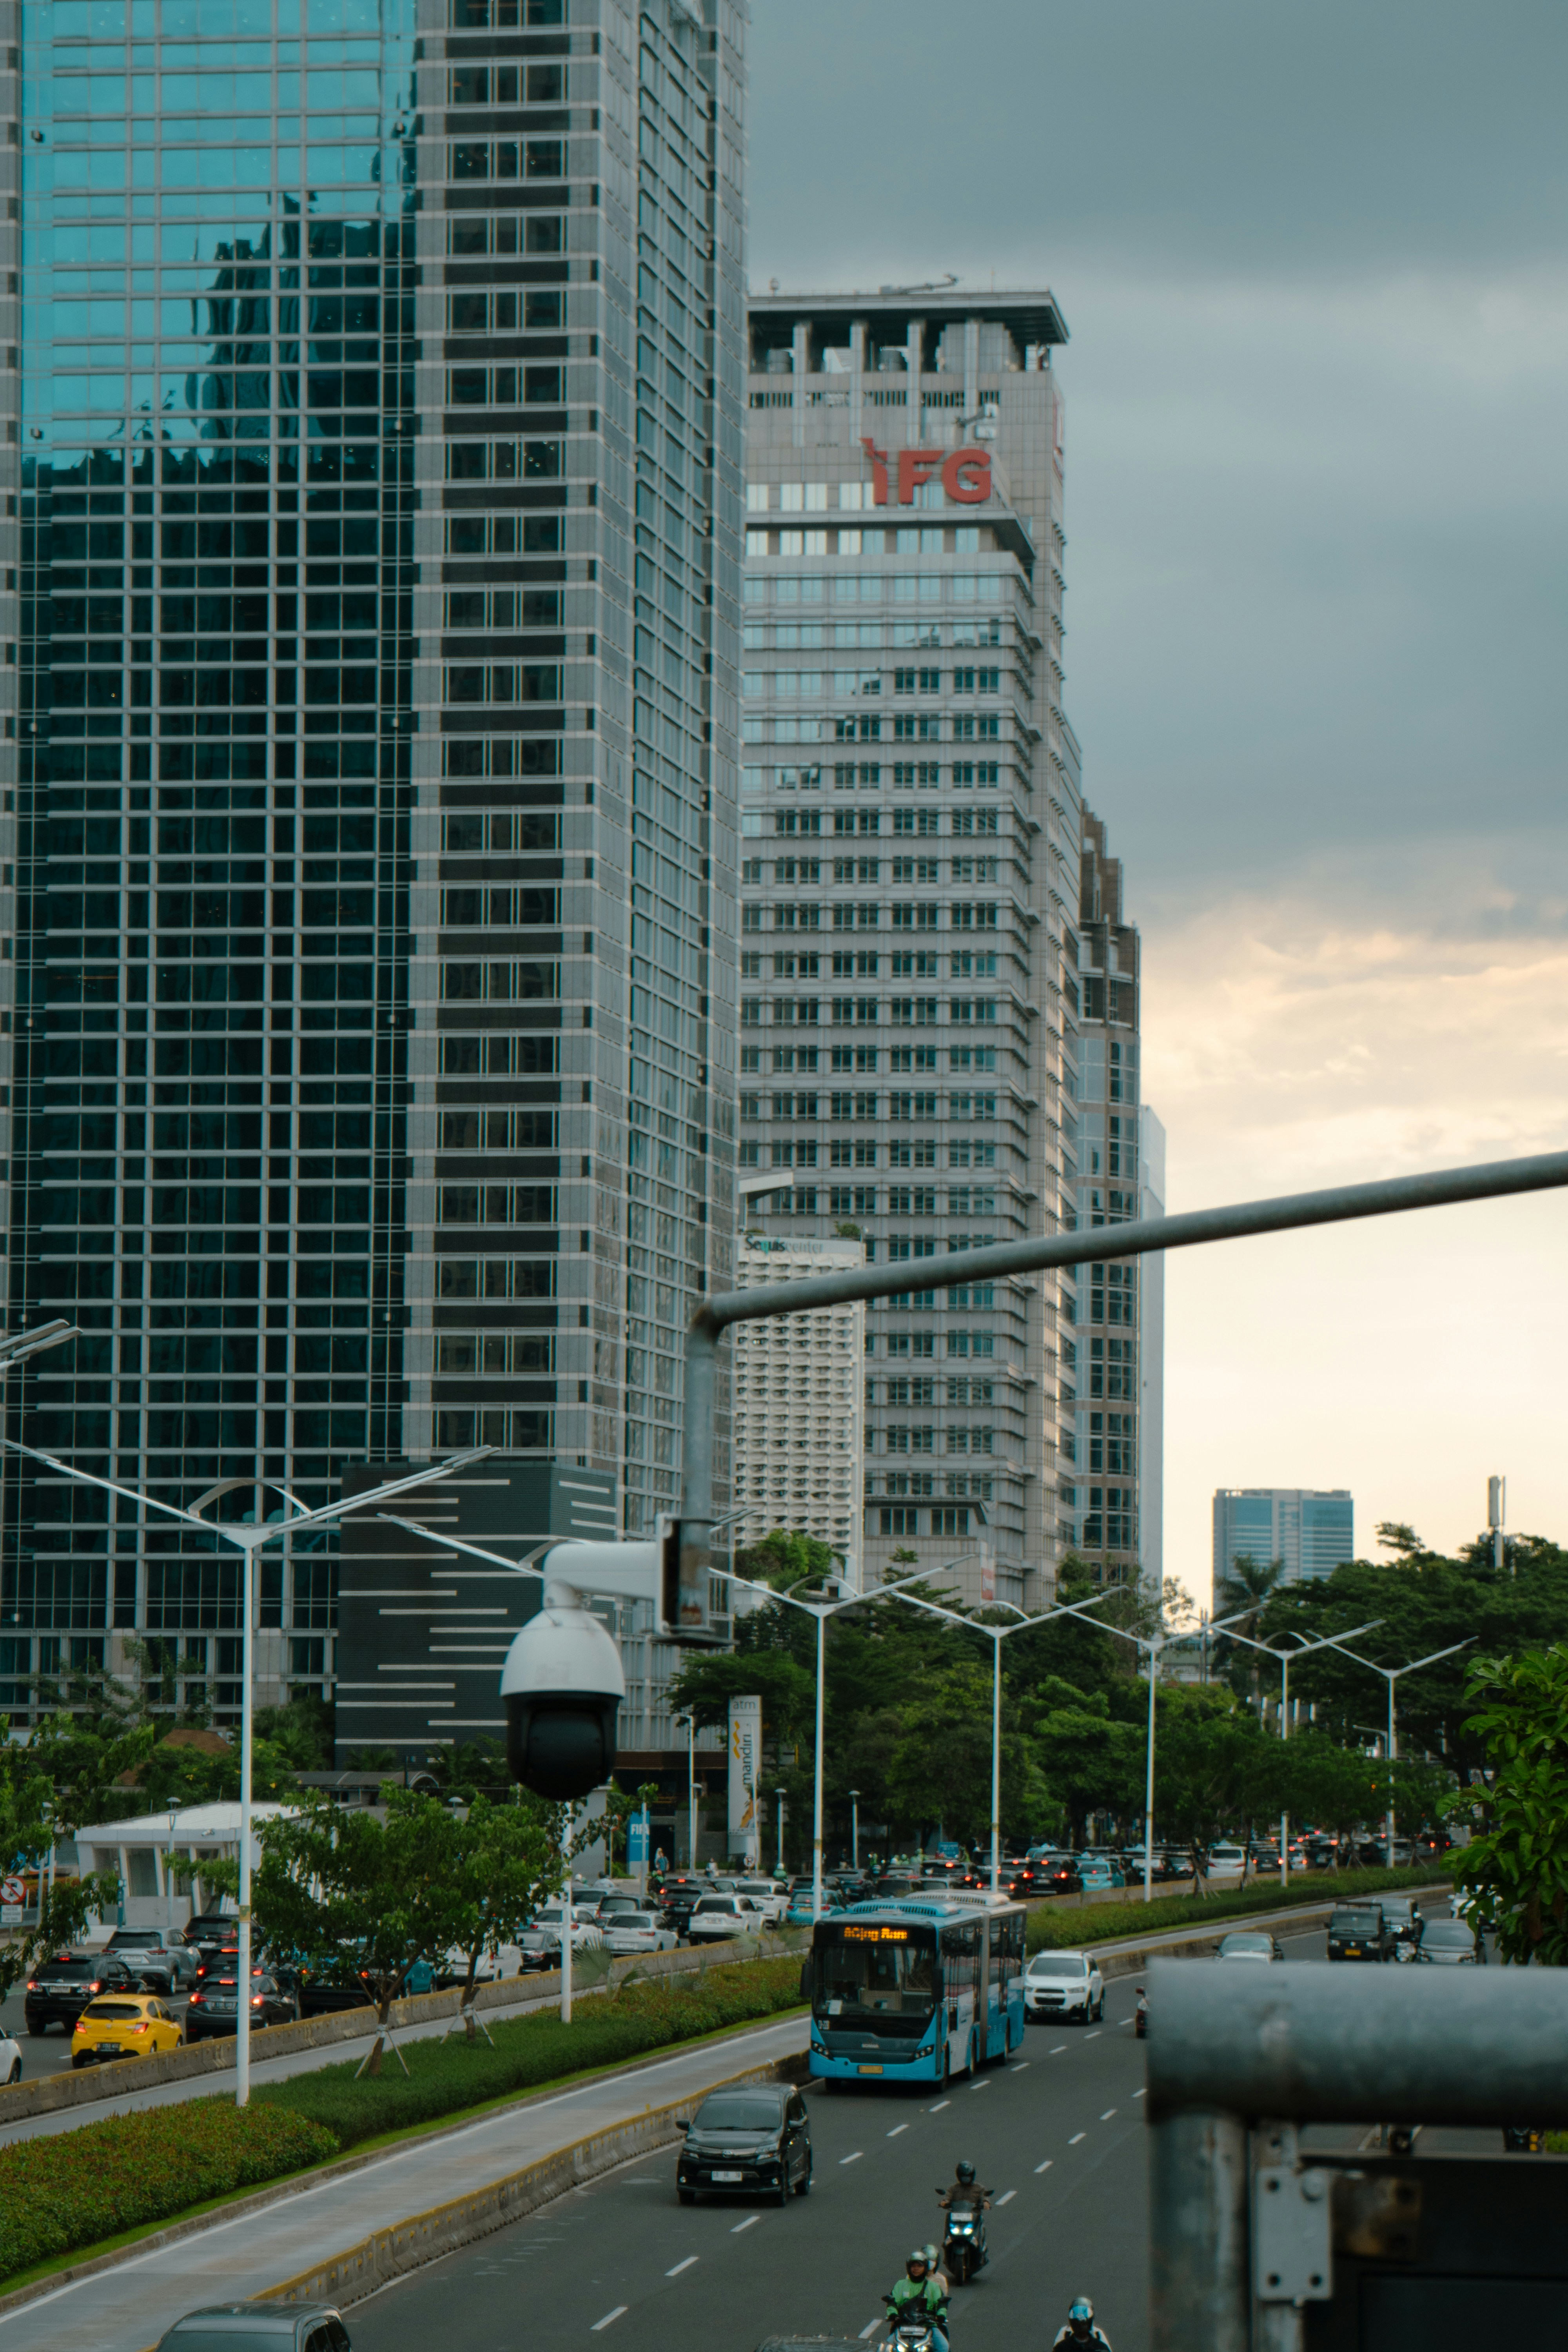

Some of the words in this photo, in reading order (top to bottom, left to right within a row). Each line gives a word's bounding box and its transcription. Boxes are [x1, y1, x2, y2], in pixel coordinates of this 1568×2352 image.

[858, 437, 991, 505] IFG
[733, 1699, 756, 1710] atm
[740, 1734, 752, 1785] mandiri
